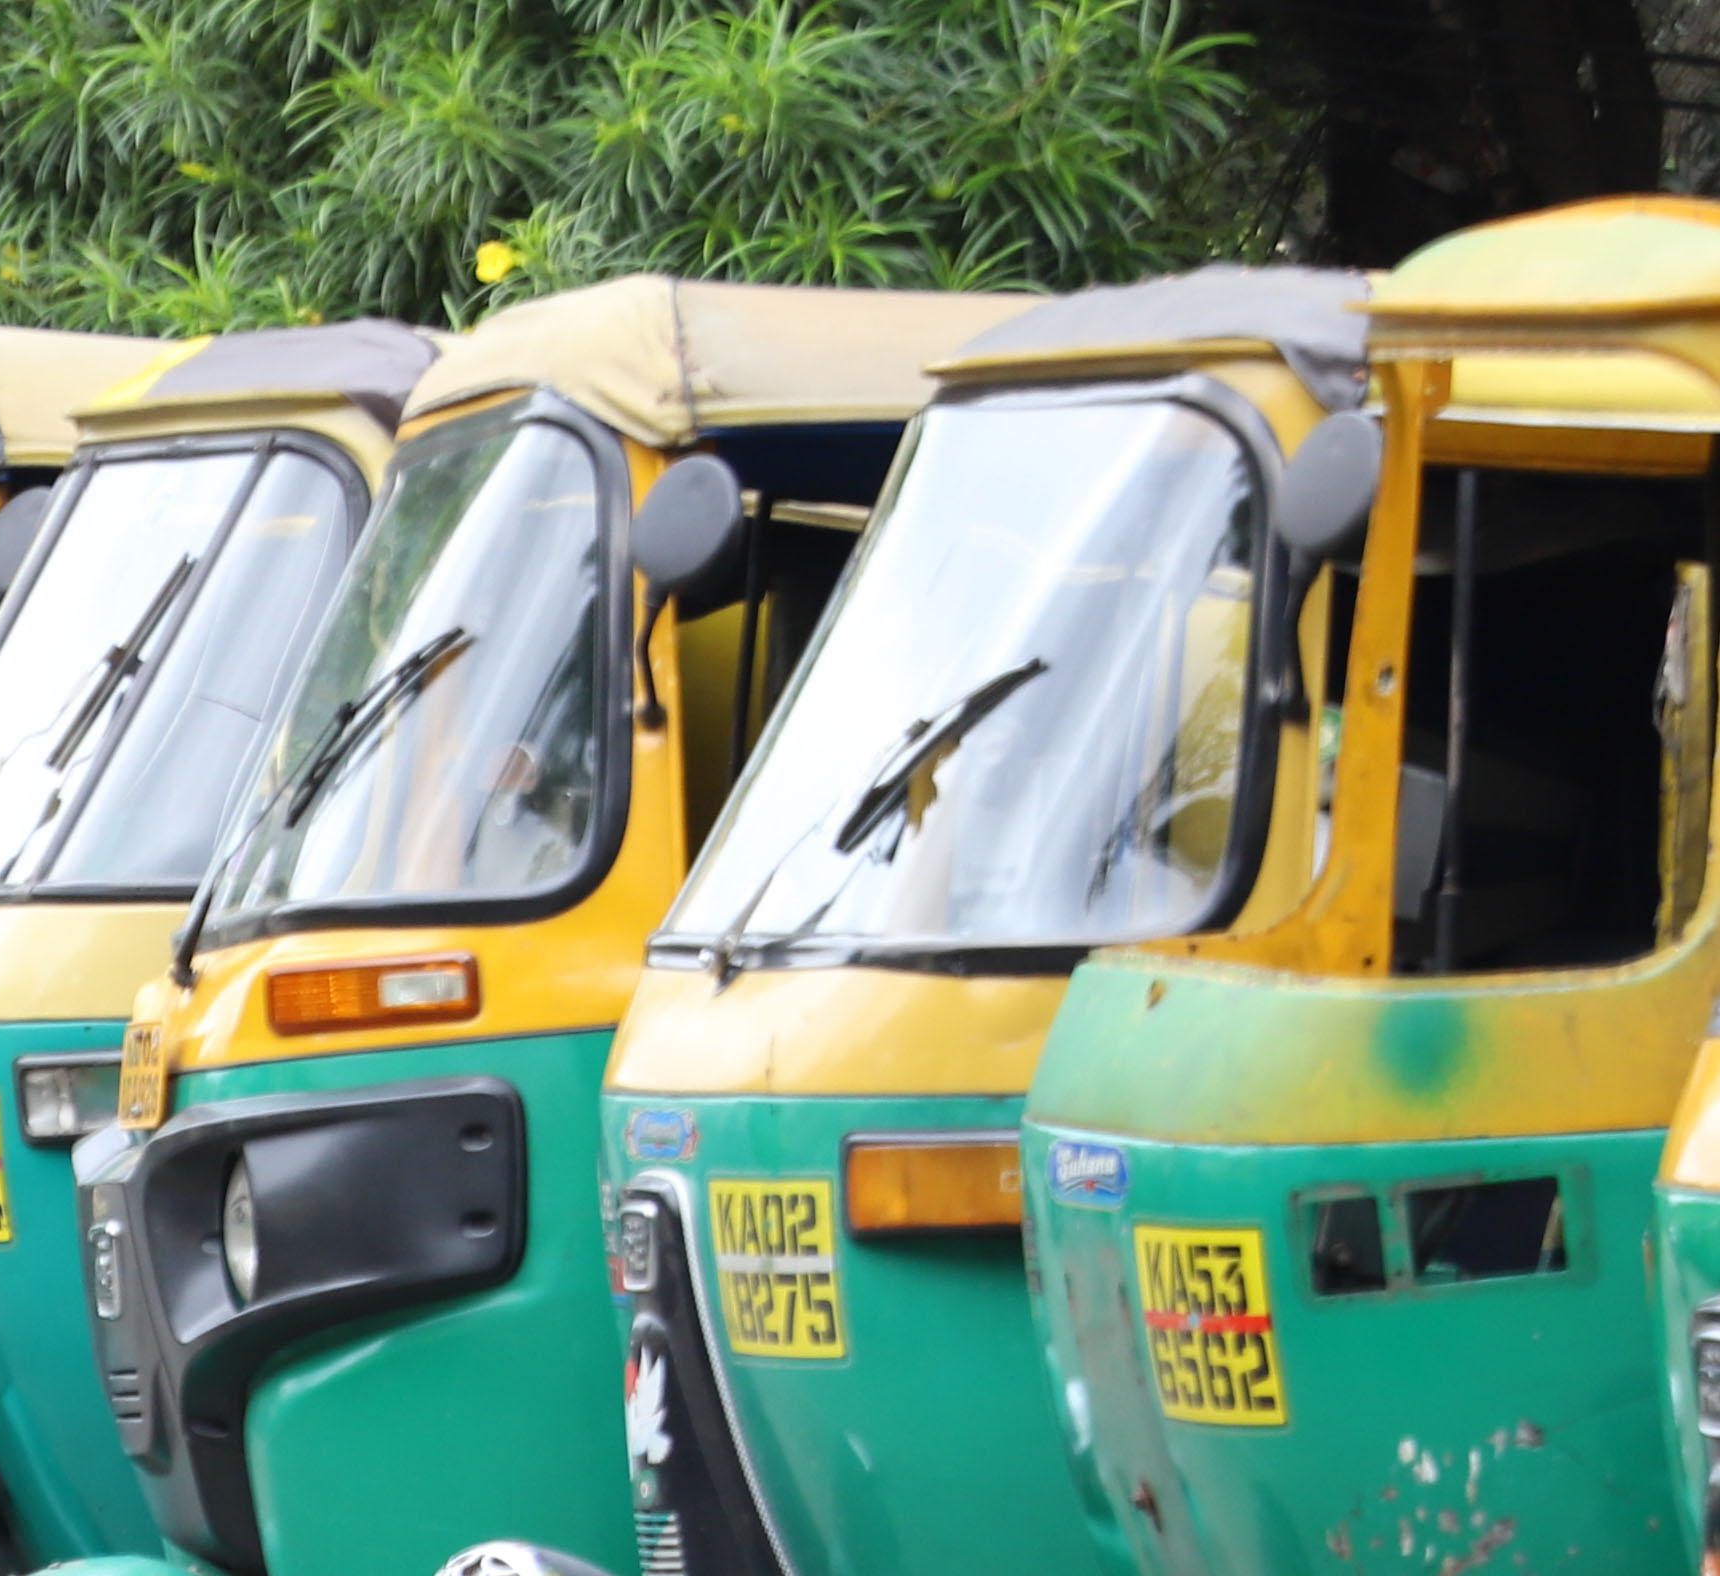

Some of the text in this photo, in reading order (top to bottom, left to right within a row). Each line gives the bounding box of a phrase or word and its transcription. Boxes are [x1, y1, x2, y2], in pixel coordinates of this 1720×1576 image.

[716, 1193, 818, 1257] KA02
[1144, 1241, 1249, 1316] KA53
[1150, 1329, 1276, 1412] 6562
